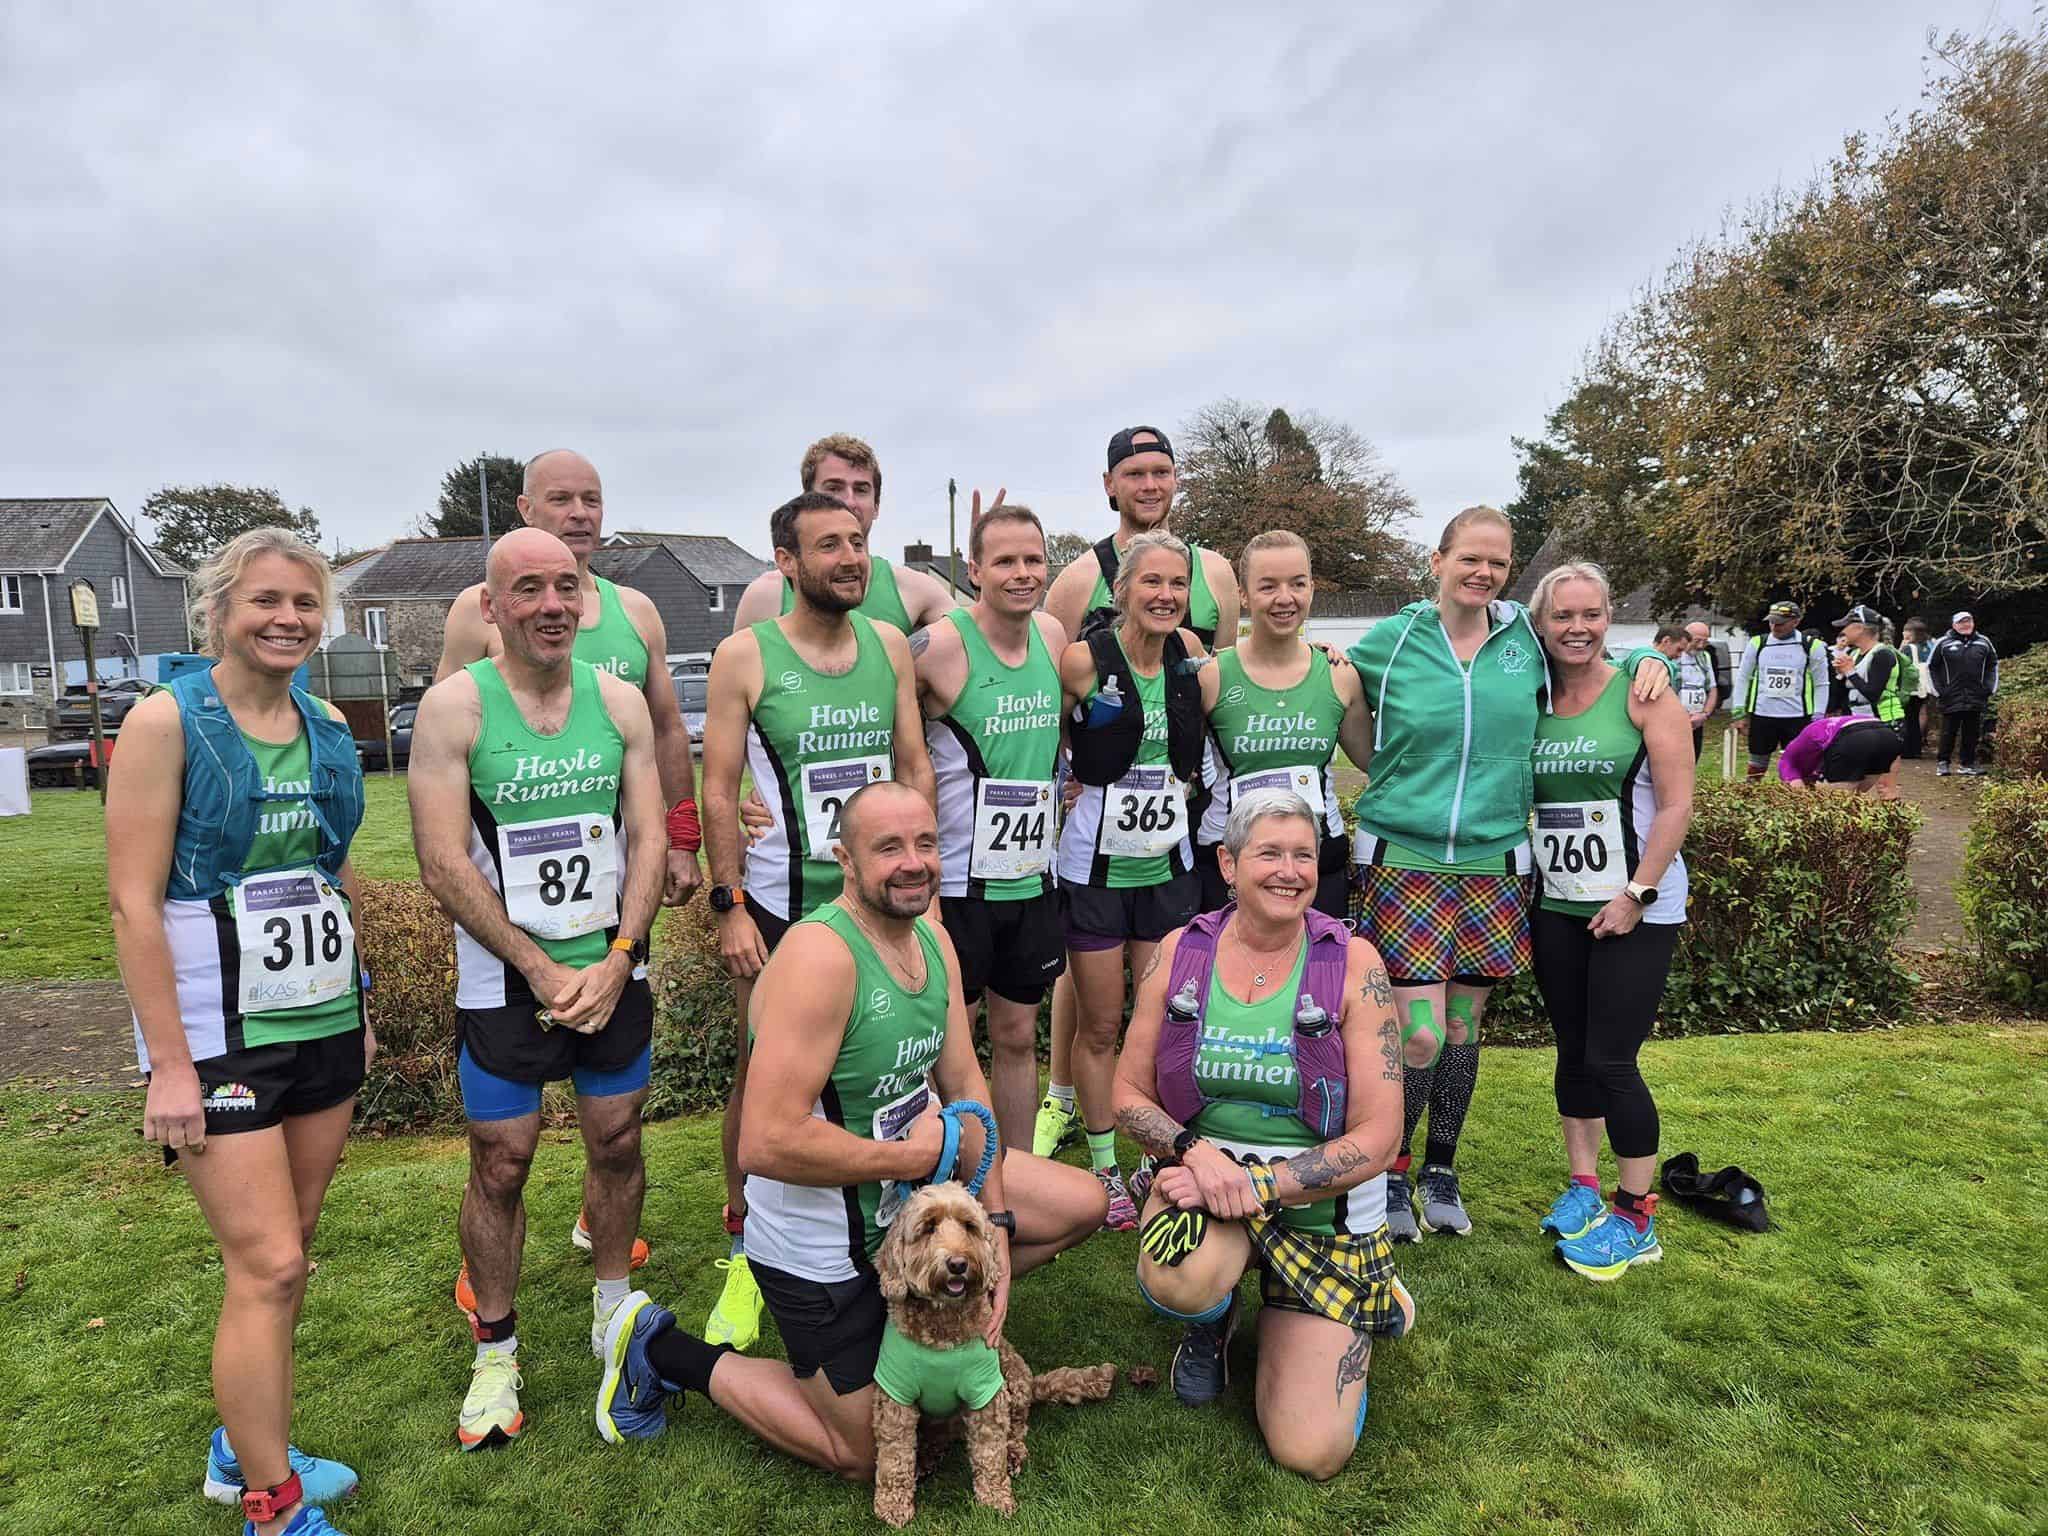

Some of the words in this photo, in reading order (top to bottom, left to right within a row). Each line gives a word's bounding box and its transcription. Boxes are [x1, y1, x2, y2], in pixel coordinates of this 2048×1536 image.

[1768, 676, 1791, 689] 289
[809, 701, 880, 730] Hayle
[996, 690, 1051, 715] Hayle
[983, 713, 1061, 736] Runners
[1245, 711, 1317, 735] Hayle
[797, 729, 891, 754] Runners
[1232, 735, 1329, 754] Runners
[512, 749, 601, 781] Hayle
[493, 774, 616, 805] Runners
[1117, 795, 1176, 832] 365
[988, 811, 1045, 851] 244
[1544, 834, 1608, 873] 260
[539, 854, 592, 906] 82
[263, 910, 342, 972] 318
[892, 1026, 944, 1069] Hayle
